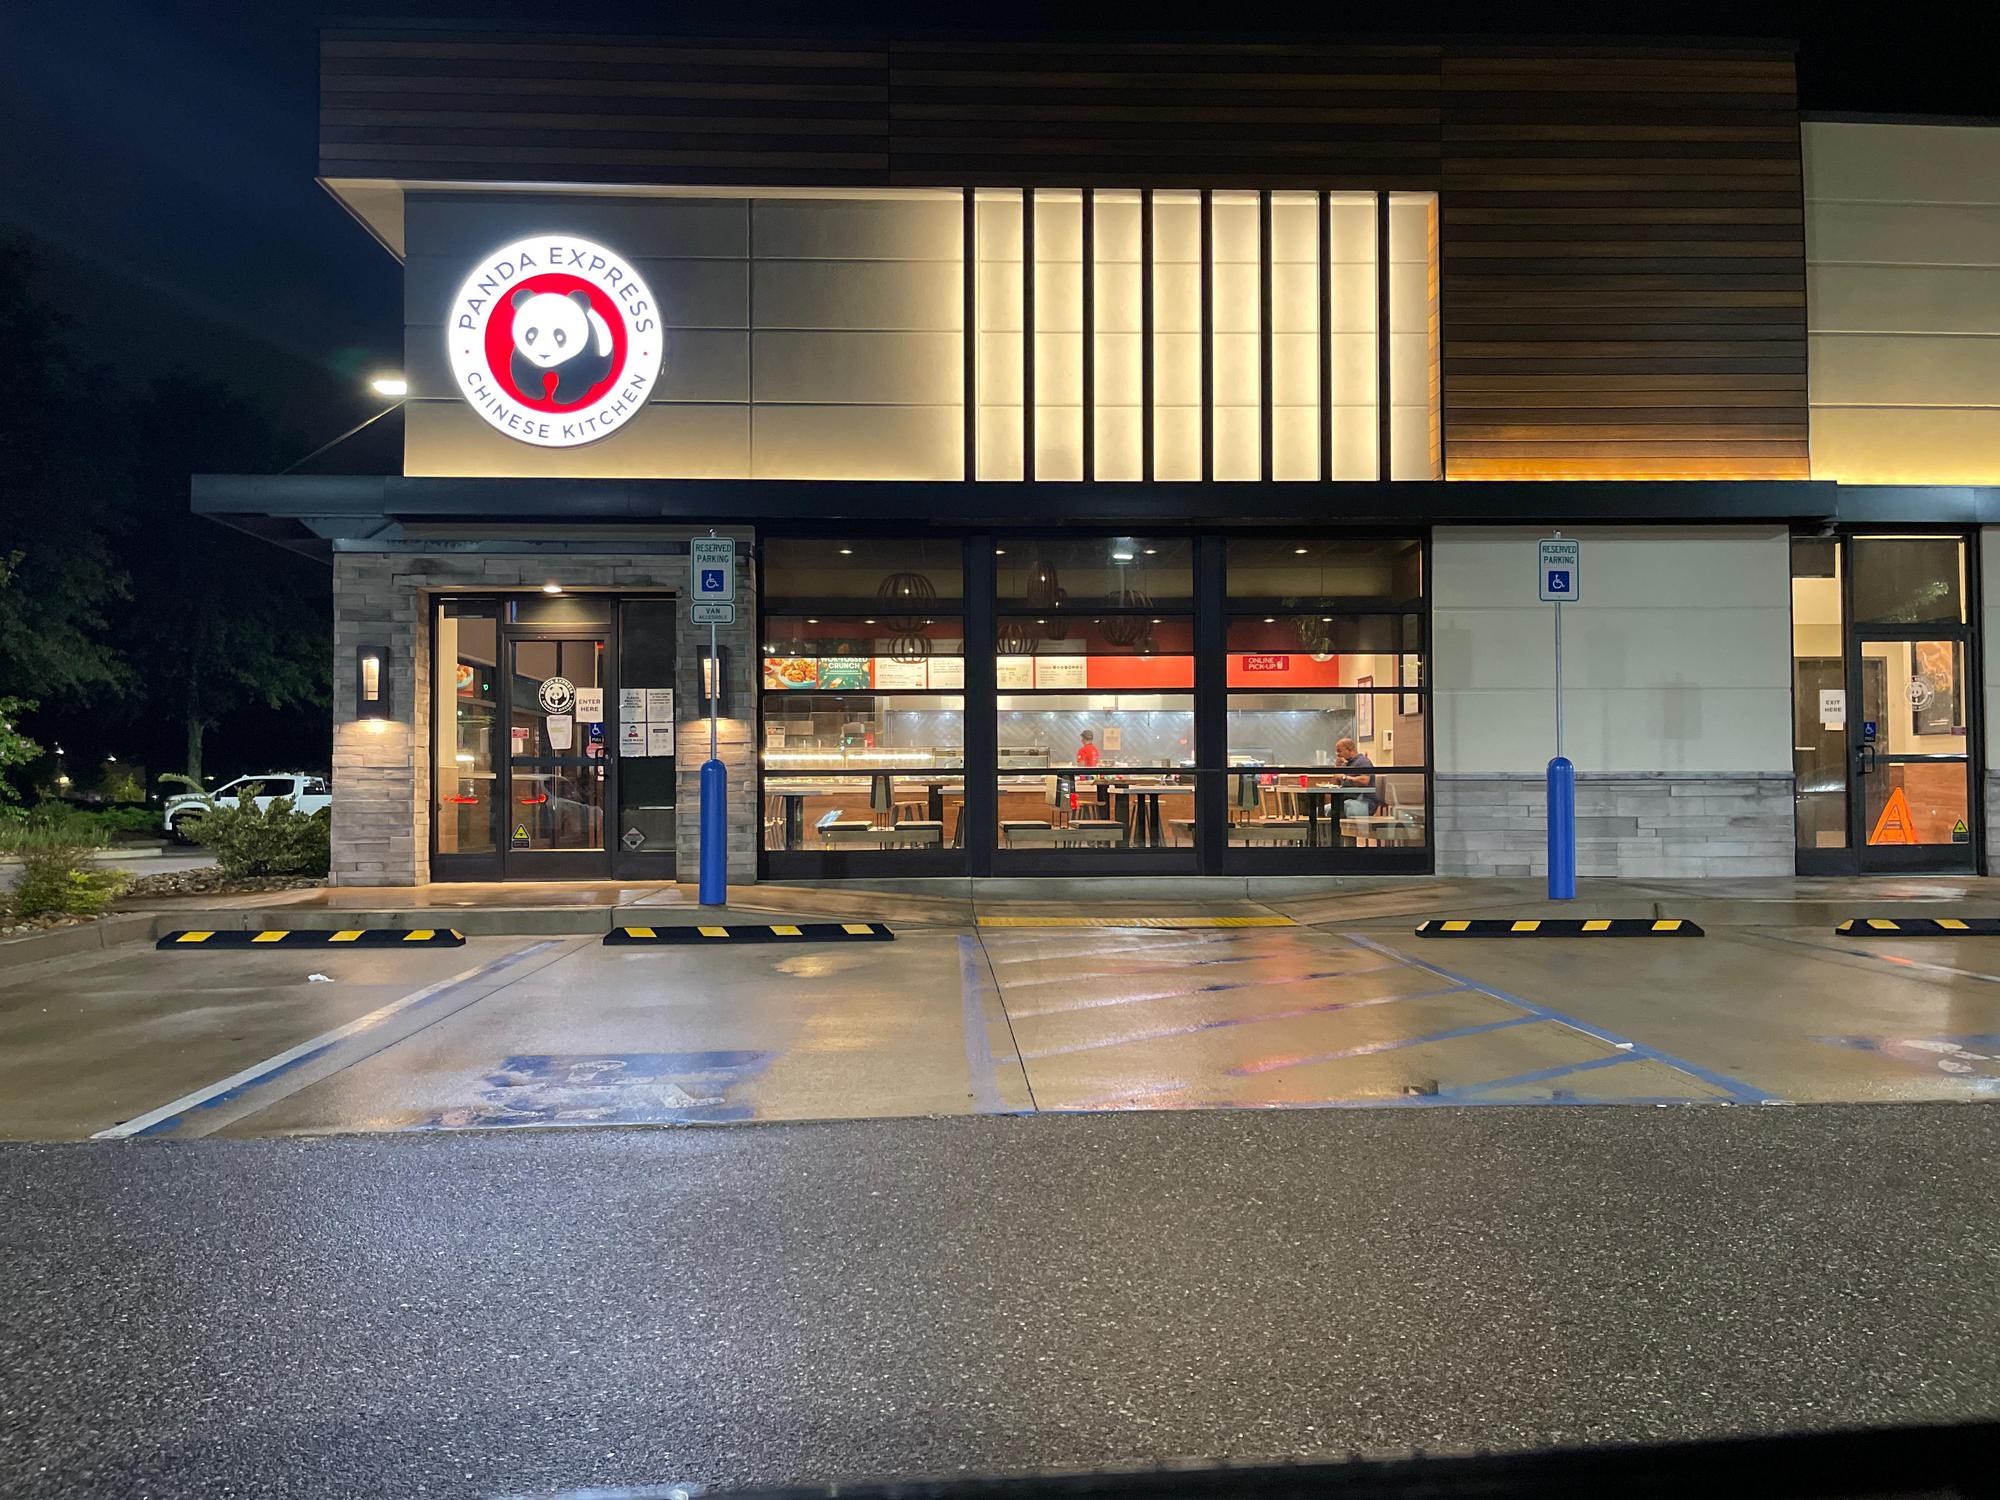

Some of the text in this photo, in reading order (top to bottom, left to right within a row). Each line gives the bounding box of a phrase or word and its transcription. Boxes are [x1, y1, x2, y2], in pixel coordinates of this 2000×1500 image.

[458, 247, 654, 333] PANDA EXPRESS
[467, 372, 647, 439] CHINESE KITCHEN
[695, 544, 732, 553] RESERVED
[1542, 545, 1577, 553] RESERVED
[697, 555, 729, 563] PARKING
[1543, 555, 1575, 564] PARKING
